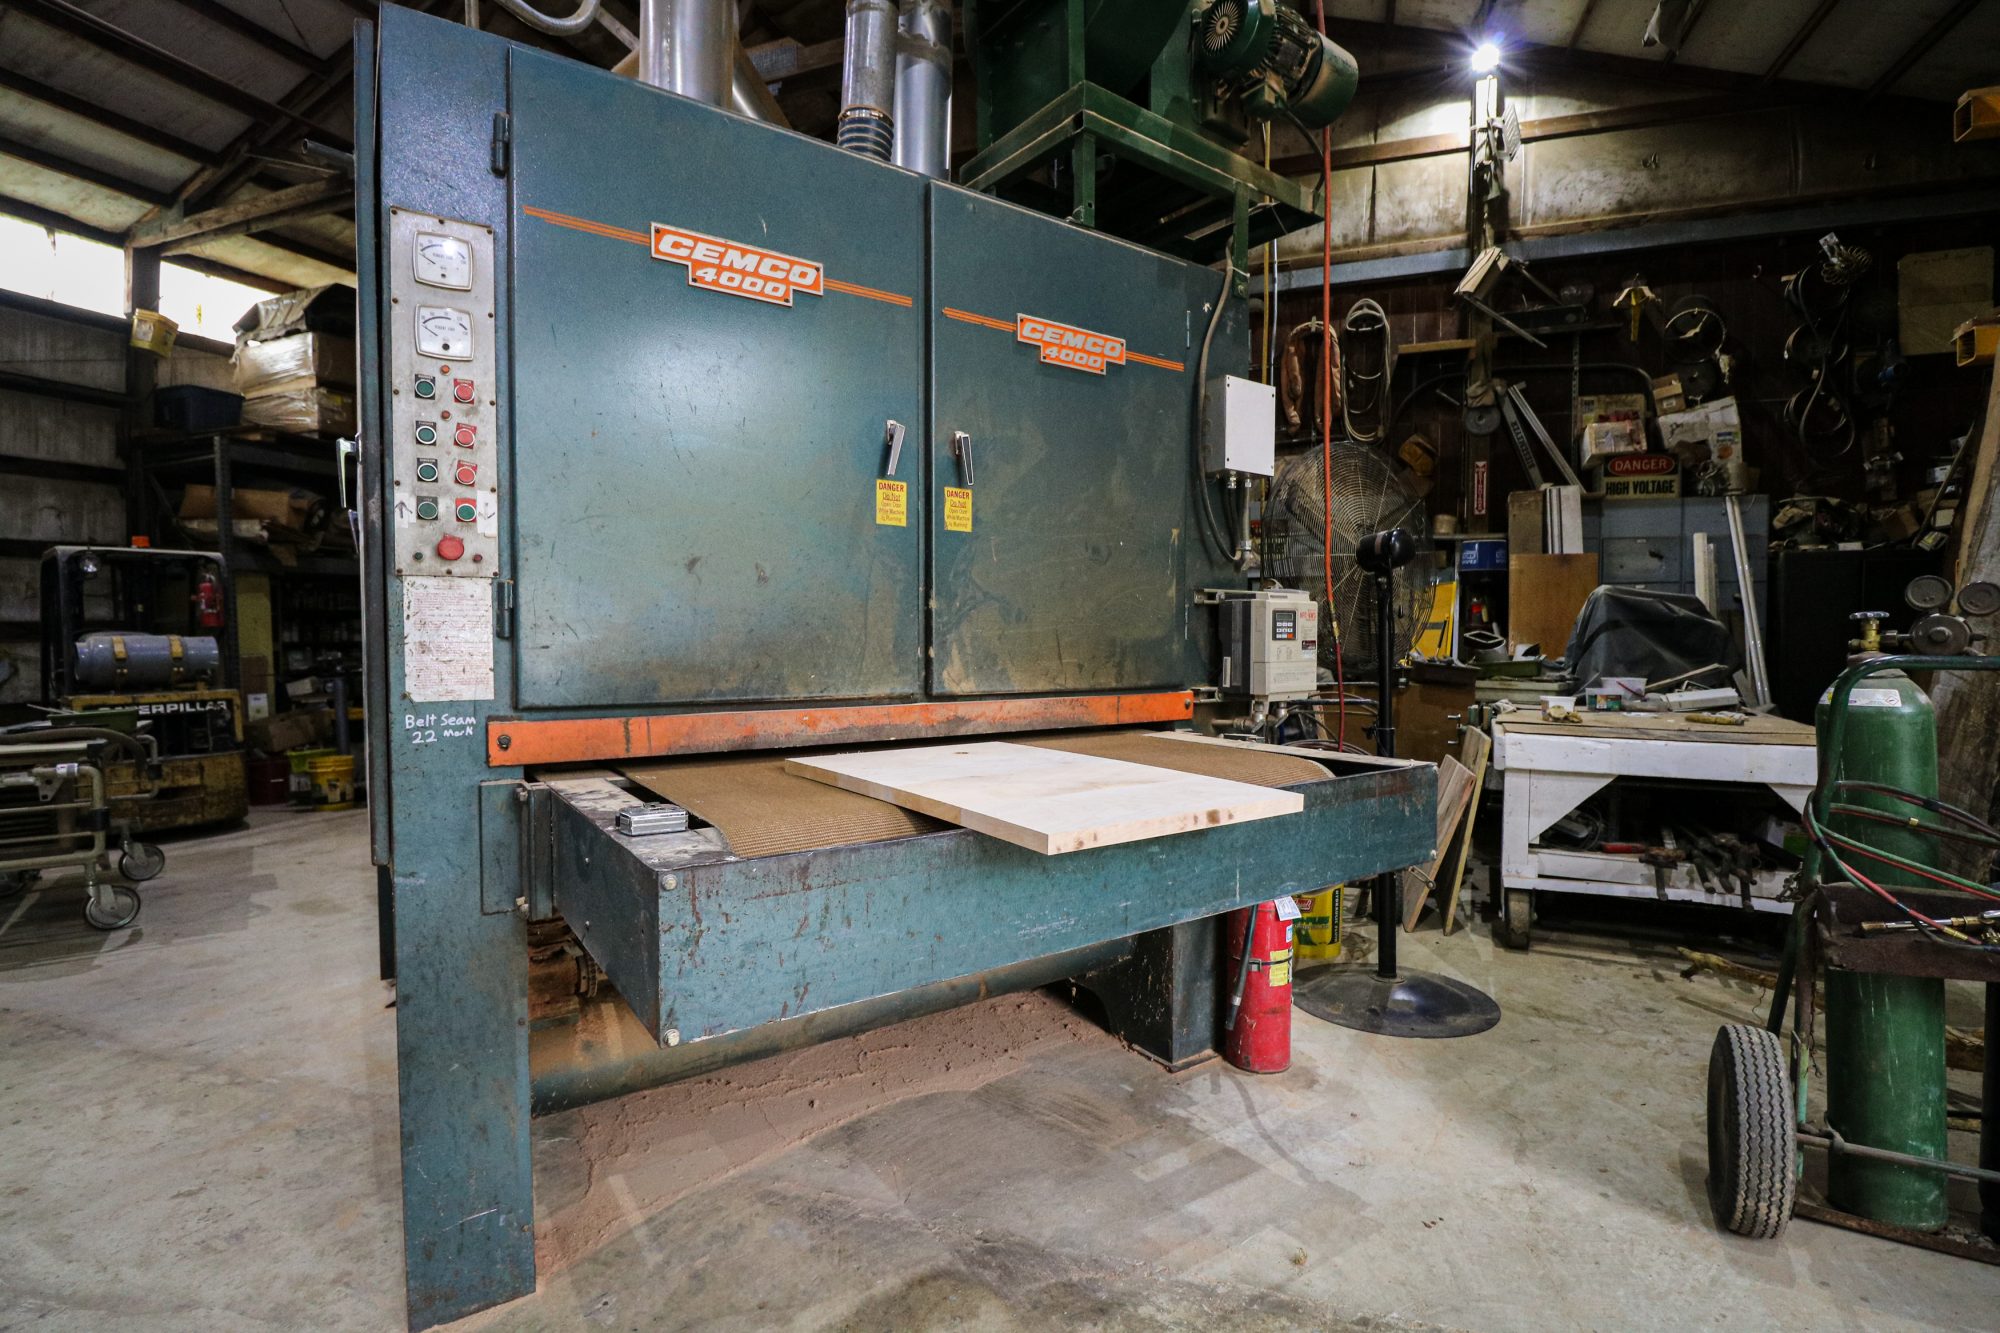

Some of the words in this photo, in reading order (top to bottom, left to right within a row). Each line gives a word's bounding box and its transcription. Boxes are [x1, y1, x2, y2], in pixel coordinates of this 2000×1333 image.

[658, 233, 817, 286] CEMCO
[695, 267, 787, 298] 4000
[1022, 322, 1121, 358] CEMCO
[1045, 346, 1101, 368] 4000
[1615, 459, 1667, 471] DANGER
[879, 483, 904, 492] DANGER
[947, 491, 969, 499] DANGER
[1605, 481, 1629, 495] HIGH
[1632, 479, 1675, 494] VOLTAGE
[405, 713, 437, 729] Belt
[440, 713, 477, 727] Seam
[412, 730, 438, 744] 22
